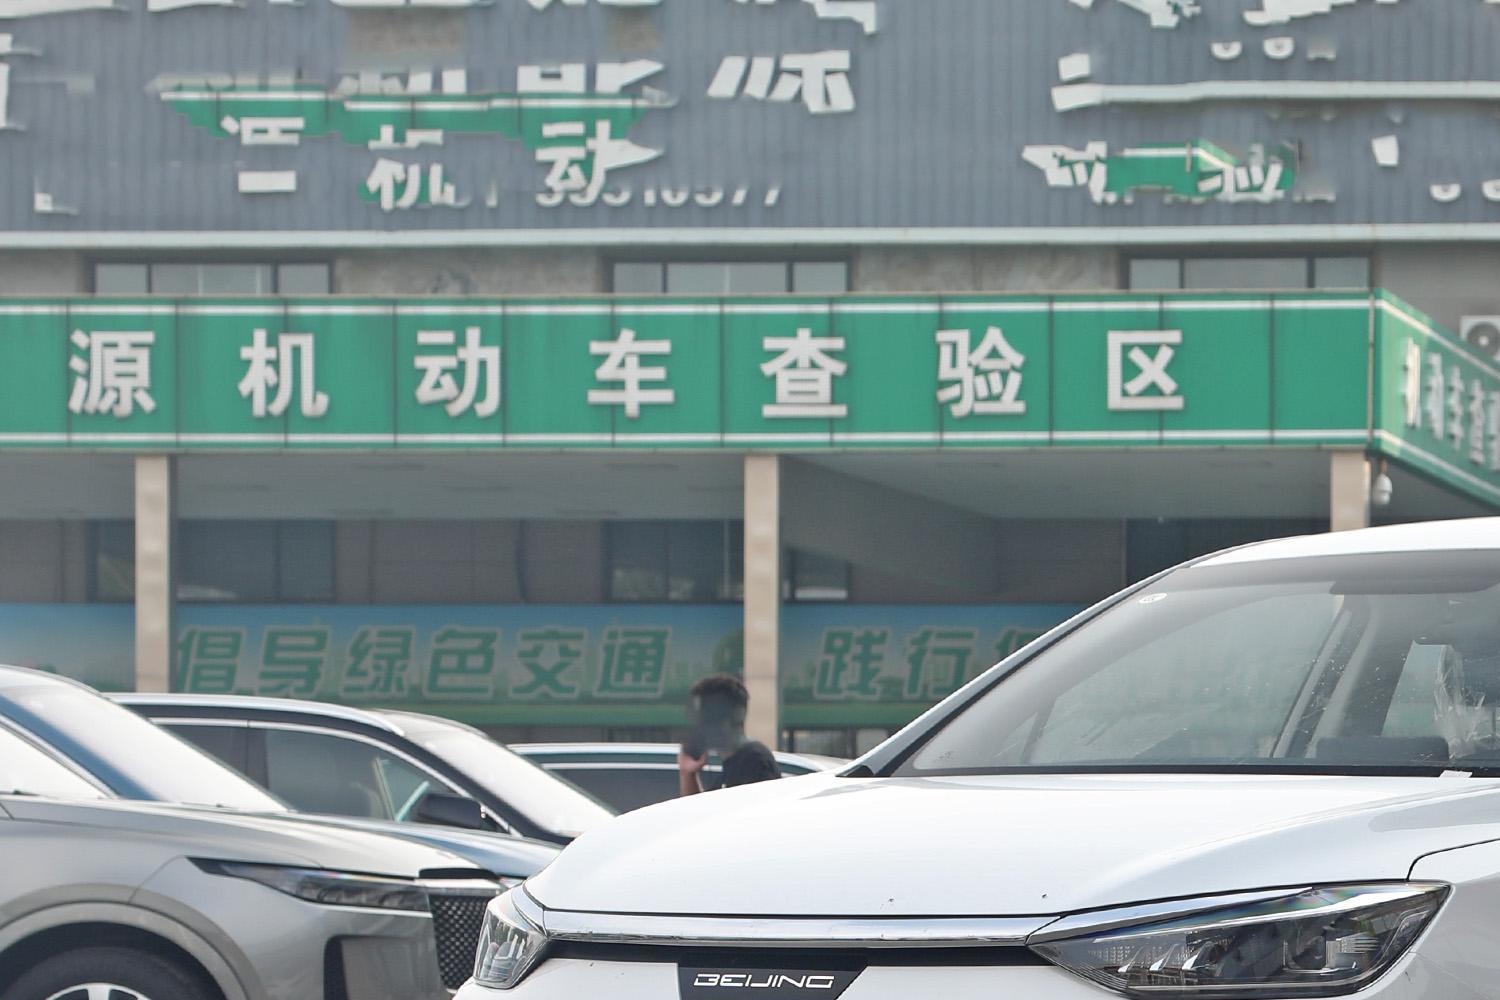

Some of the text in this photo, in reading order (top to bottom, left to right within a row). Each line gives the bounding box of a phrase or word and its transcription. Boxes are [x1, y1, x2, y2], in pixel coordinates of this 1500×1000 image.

[67, 325, 1185, 418] 源机动车查验区
[177, 625, 1050, 700] 倡导绿色交通 践行
[693, 973, 835, 989] BEIJING
